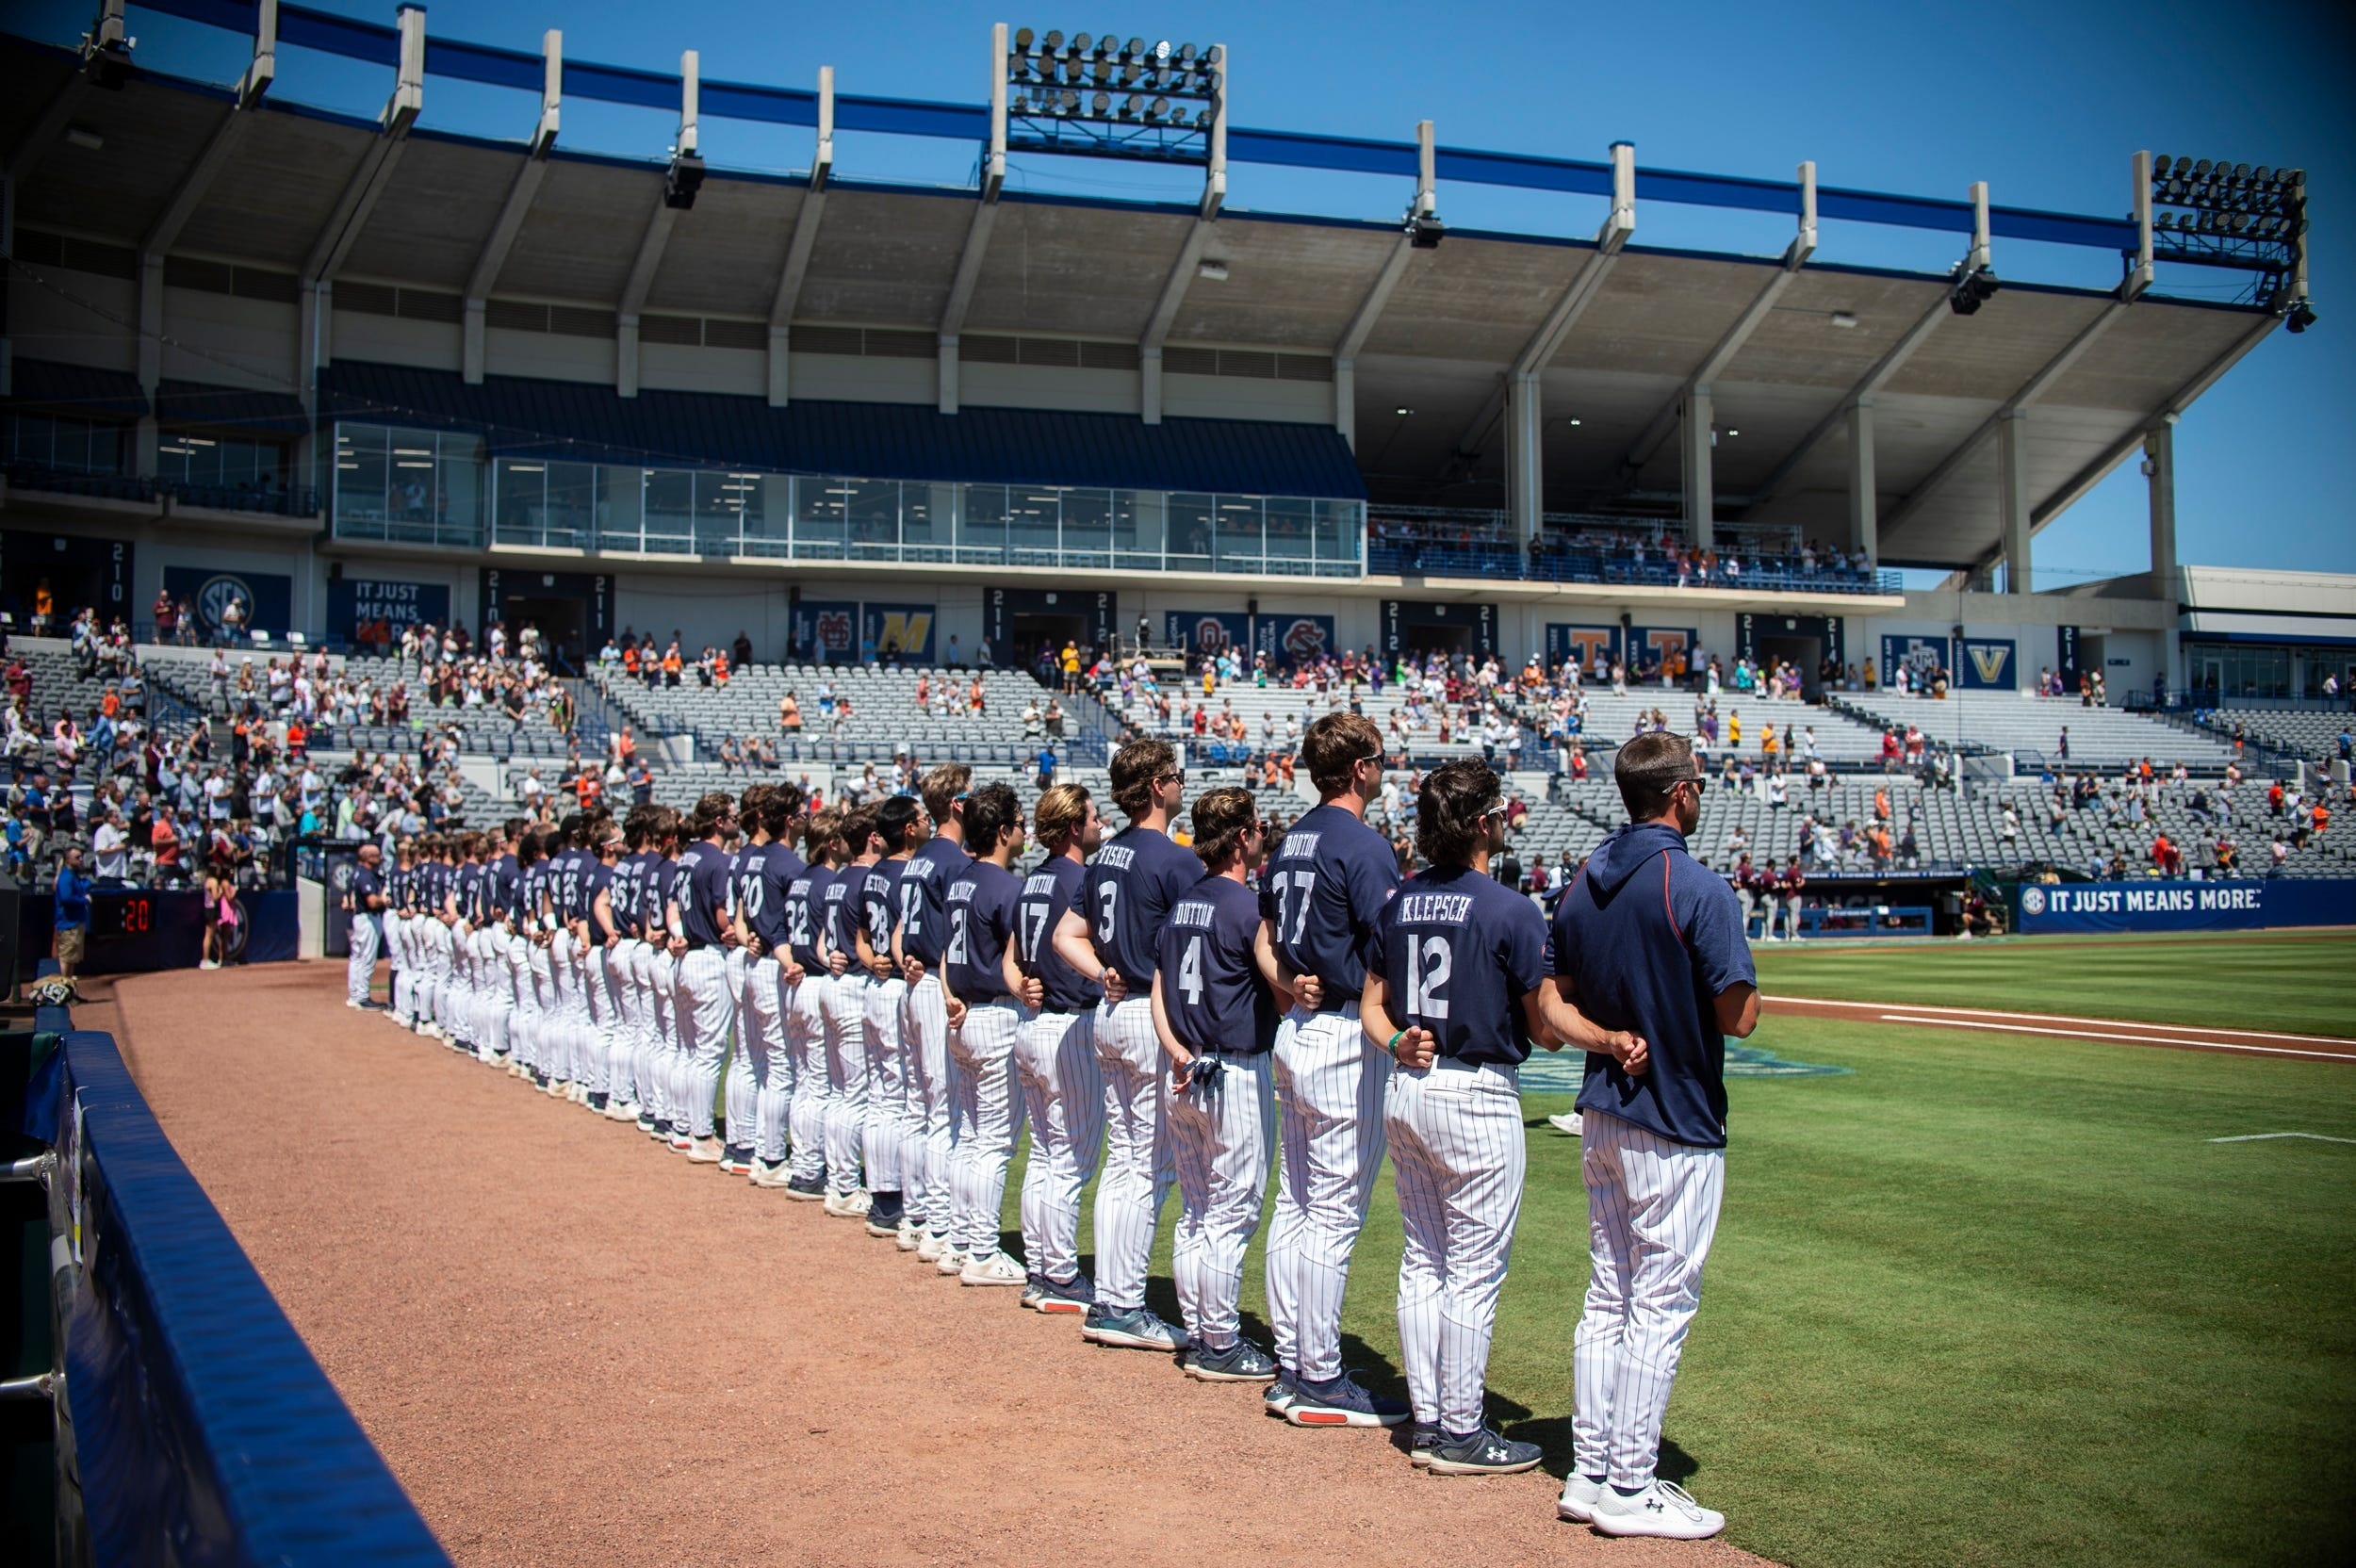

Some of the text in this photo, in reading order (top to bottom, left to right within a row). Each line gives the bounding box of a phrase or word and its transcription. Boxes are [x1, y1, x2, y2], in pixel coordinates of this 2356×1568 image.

[356, 582, 419, 601] IT JUST
[356, 601, 417, 620] MEANS
[595, 576, 606, 629] 211
[993, 590, 1004, 641] 211
[1389, 602, 1399, 651] 212
[2064, 627, 2073, 671] 214
[1098, 845, 1135, 871] FISHER
[1098, 880, 1118, 944] 3
[1174, 902, 1215, 928] DUTTON
[1272, 871, 1317, 945] 37
[1401, 894, 1472, 923] KLEPSCH
[2051, 890, 2070, 912] IT
[2072, 890, 2122, 912] JUST
[2126, 890, 2195, 912] MEANS
[946, 907, 968, 965] 21
[1021, 902, 1050, 962] 17
[1178, 936, 1203, 1005] 4
[1406, 933, 1453, 1020] 12
